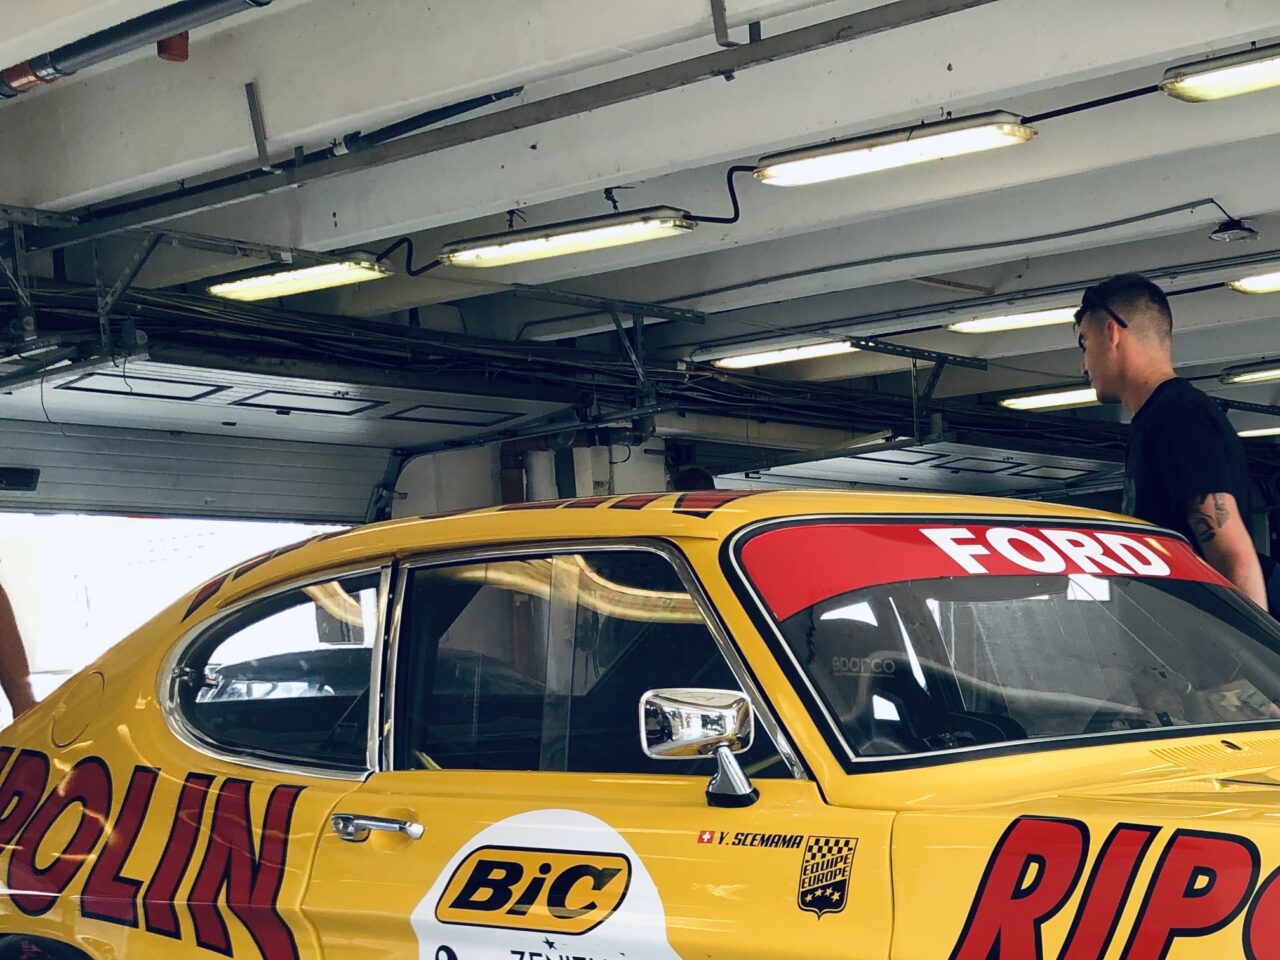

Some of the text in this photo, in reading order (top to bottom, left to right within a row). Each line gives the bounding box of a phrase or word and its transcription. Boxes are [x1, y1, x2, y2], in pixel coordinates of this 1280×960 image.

[919, 527, 1171, 577] FORD
[718, 831, 805, 849] Y. SCEMAMA
[802, 852, 852, 877] EQUIPE
[801, 865, 850, 889] EUROPE
